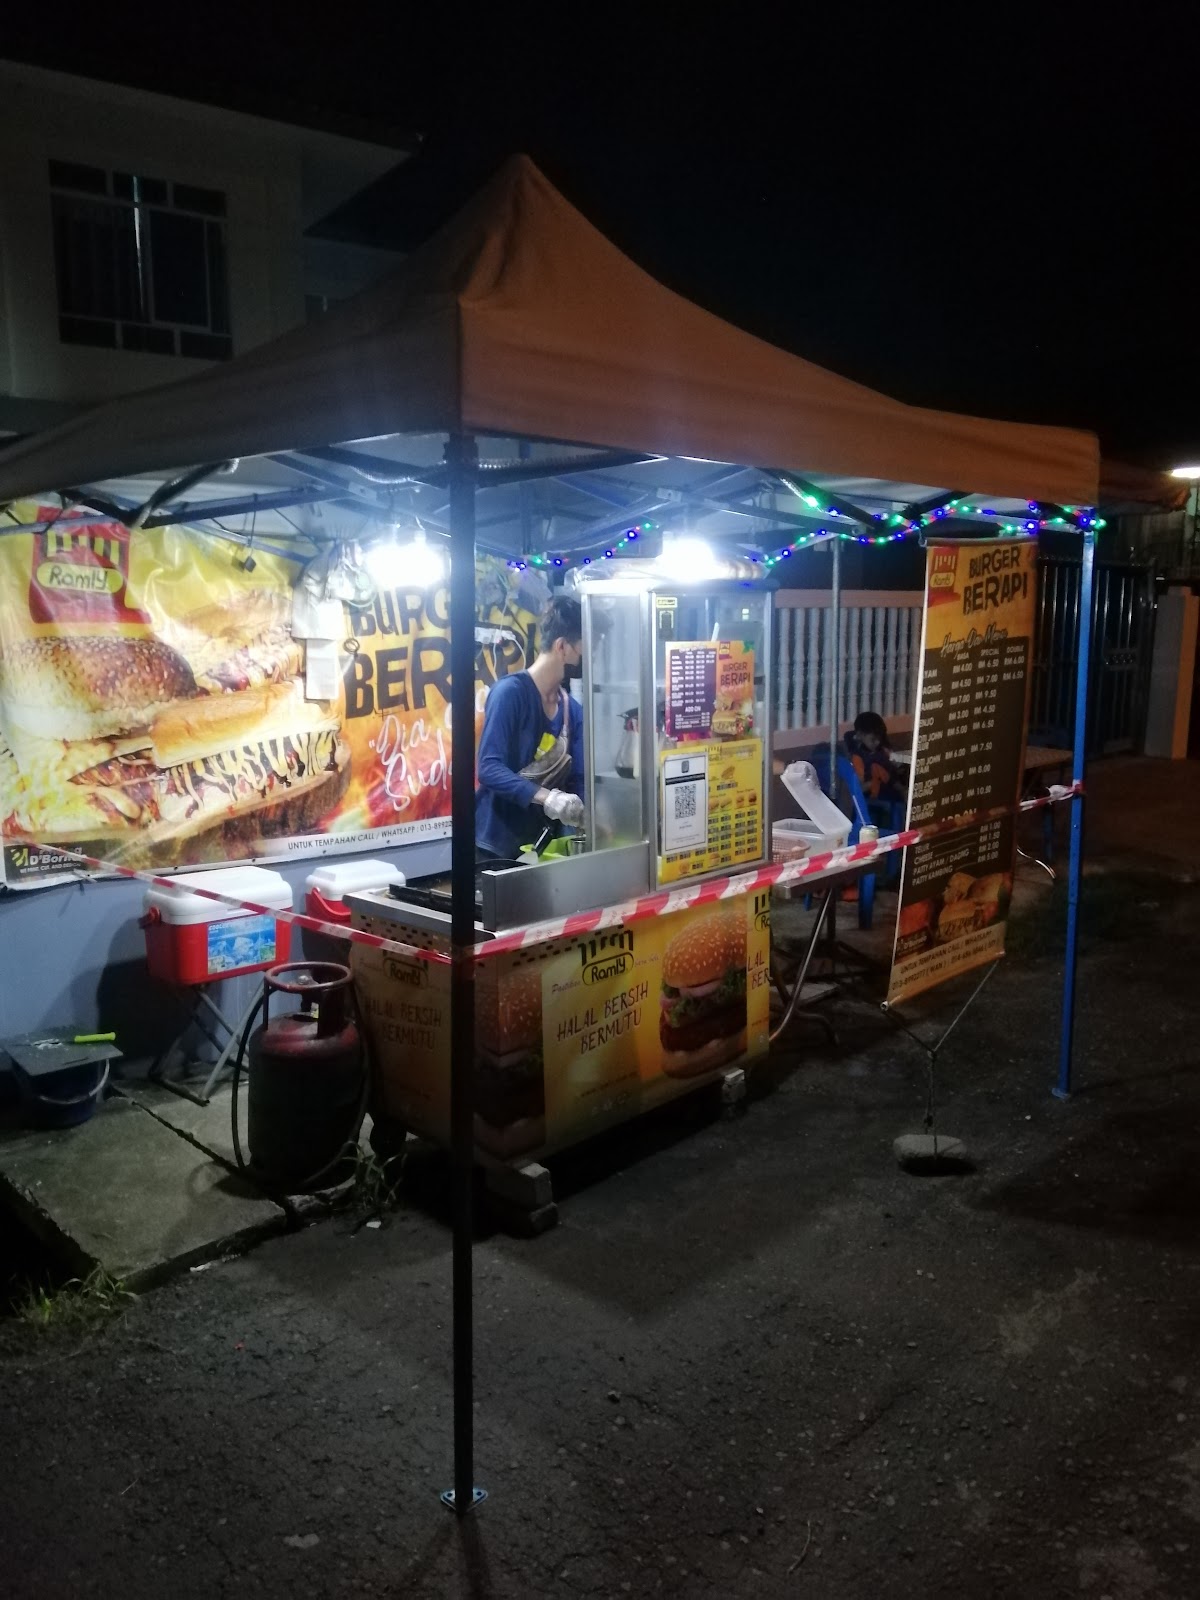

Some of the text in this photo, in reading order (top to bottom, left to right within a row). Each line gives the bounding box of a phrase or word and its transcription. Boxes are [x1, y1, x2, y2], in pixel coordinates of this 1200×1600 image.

[969, 546, 1020, 578] BURGER
[49, 565, 108, 590] Ramly
[963, 572, 1027, 615] BERAPI
[721, 673, 750, 686] BERAPI
[924, 669, 937, 678] YAM
[922, 684, 942, 694] AGING
[288, 842, 312, 850] UNTUK
[315, 837, 355, 847] TEMPAHAN
[358, 834, 374, 842] CALL
[381, 826, 414, 838] WHATSAPP
[390, 962, 420, 986] Ramly
[592, 957, 625, 982] Ramly
[557, 1008, 598, 1041] HALAL
[604, 981, 648, 1019] BERSIH
[581, 1008, 642, 1054] BERMUTU
